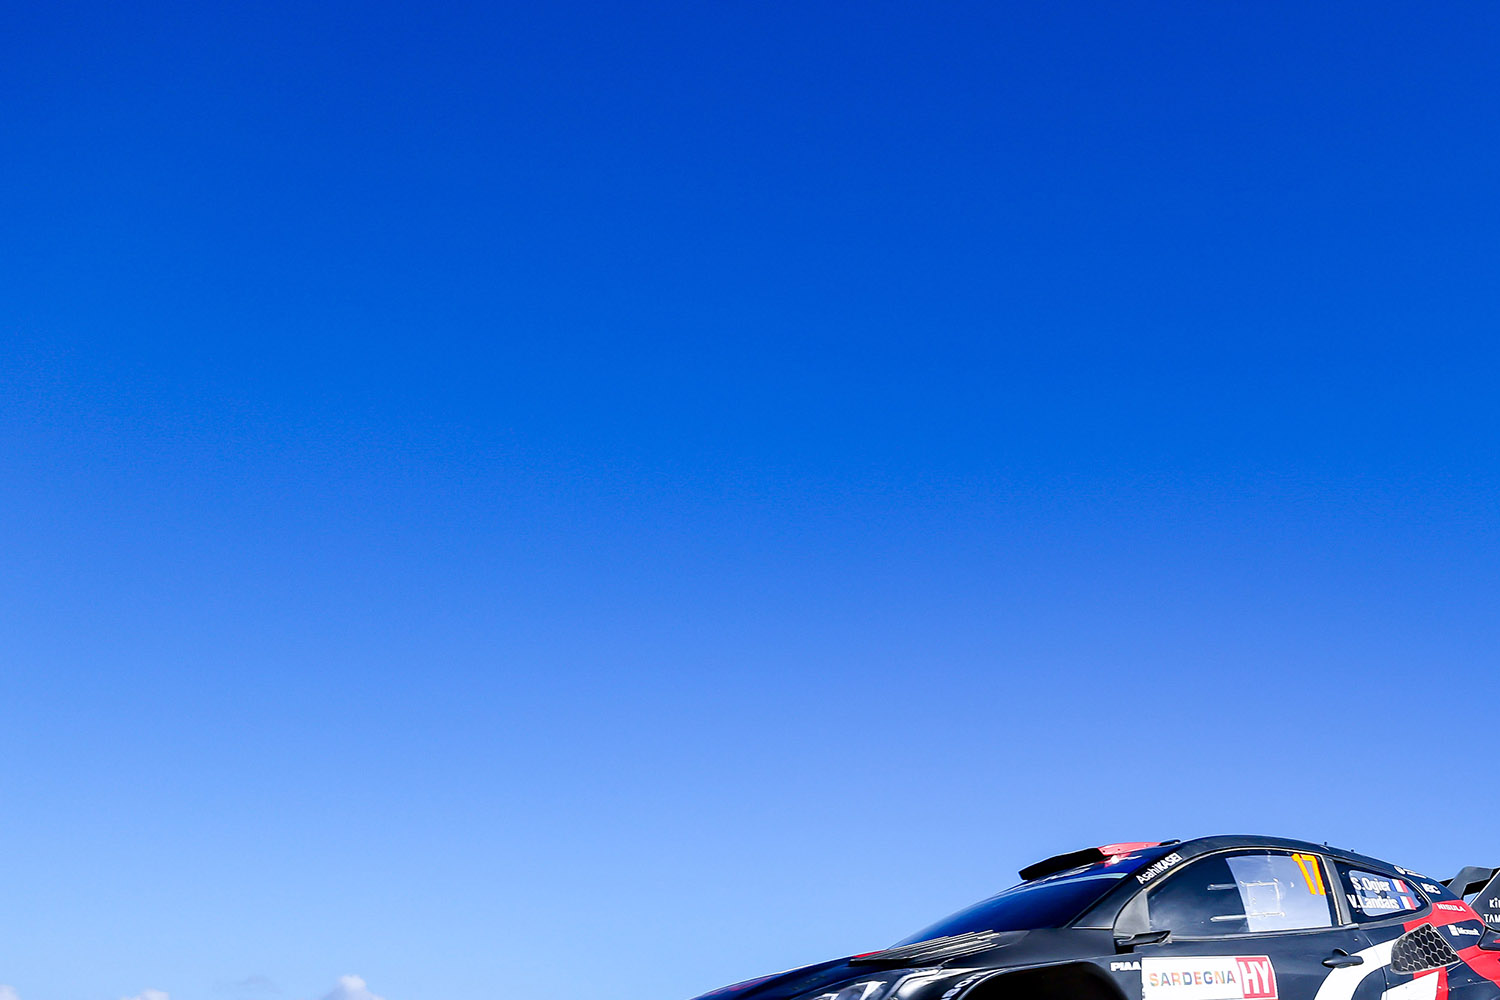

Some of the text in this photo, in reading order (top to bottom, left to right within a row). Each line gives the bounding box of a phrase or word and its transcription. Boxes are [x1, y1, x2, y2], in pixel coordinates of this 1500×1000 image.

[1135, 852, 1183, 885] AsahiKASEI
[1291, 853, 1326, 895] 17
[1351, 876, 1391, 894] S.Ogier
[1347, 894, 1400, 910] V.Landais
[1110, 962, 1142, 972] PIAA
[1149, 970, 1236, 987] SARDEGNA
[1238, 961, 1271, 995] HY
